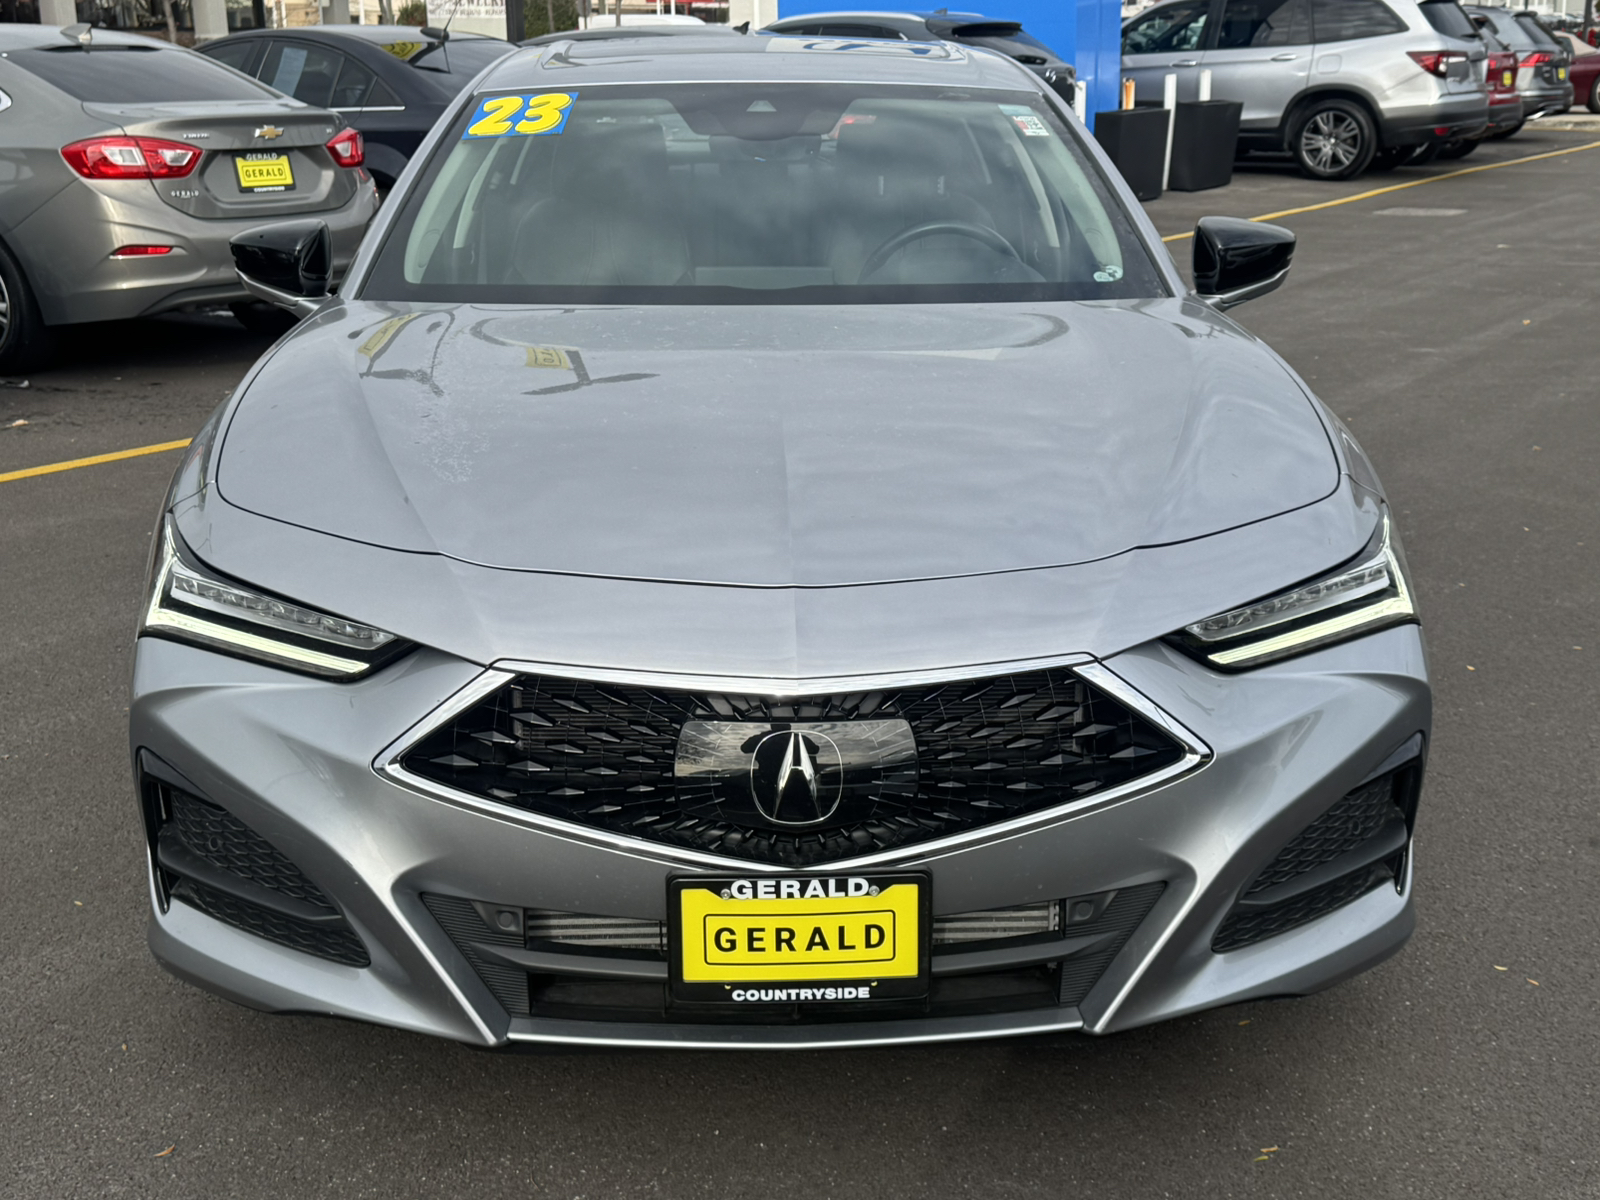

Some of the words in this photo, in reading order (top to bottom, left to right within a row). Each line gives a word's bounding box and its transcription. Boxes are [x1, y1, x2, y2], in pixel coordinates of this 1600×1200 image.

[468, 93, 573, 136] 23
[246, 152, 278, 161] GERALD
[245, 168, 284, 178] GERALD
[730, 877, 870, 900] GERALD
[714, 923, 886, 953] GERALD
[731, 986, 871, 1002] COUNTRYSIDE
